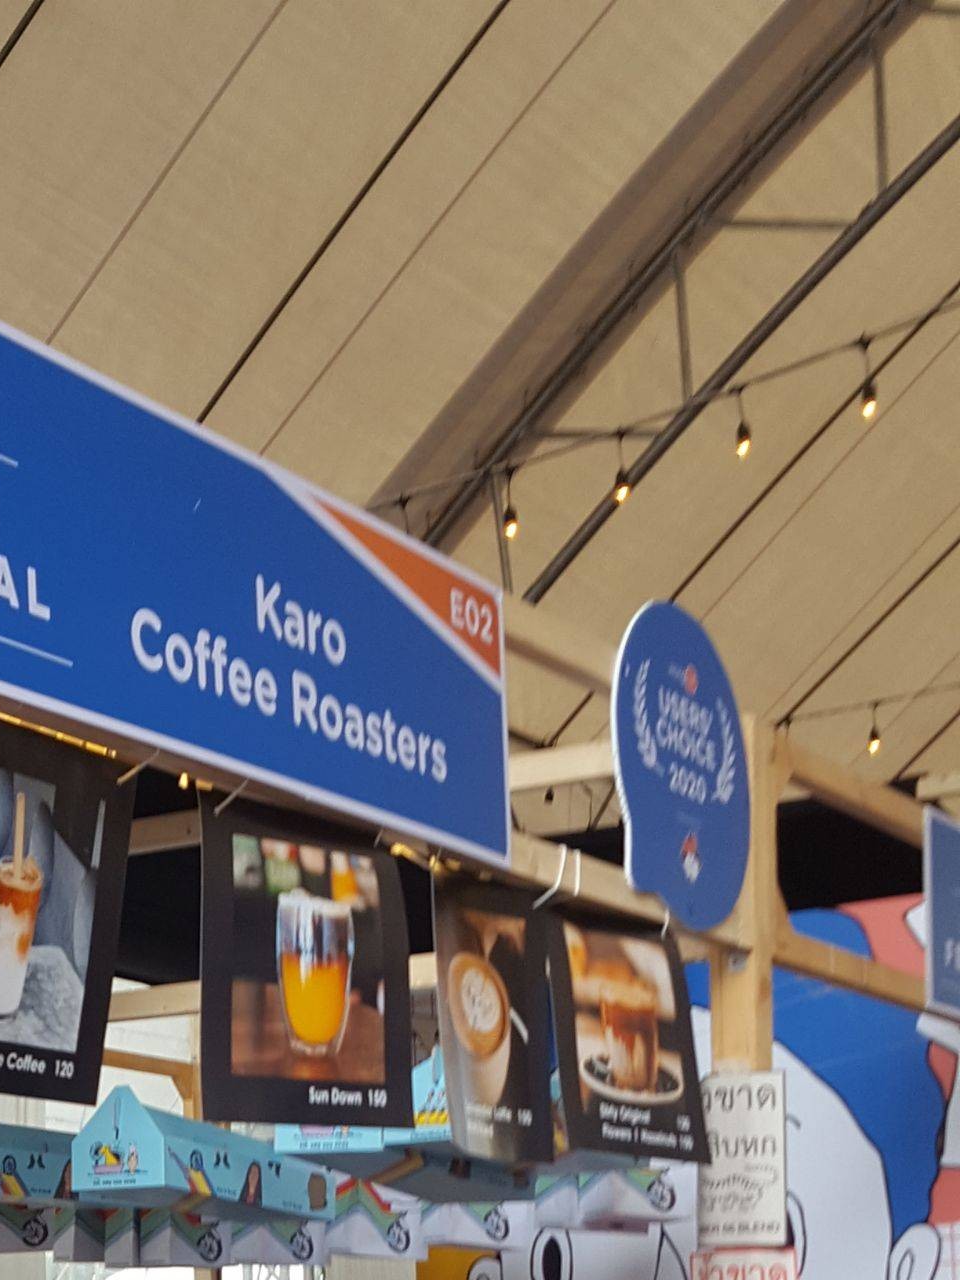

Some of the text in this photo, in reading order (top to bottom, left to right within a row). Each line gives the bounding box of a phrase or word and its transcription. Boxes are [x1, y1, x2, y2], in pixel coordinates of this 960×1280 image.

[255, 573, 347, 665] Karo
[449, 587, 493, 645] E02
[131, 607, 448, 783] Coffee Roasters
[669, 761, 707, 806] 2020
[6, 1051, 47, 1075] Coffee
[54, 1059, 75, 1079] 120
[308, 1085, 330, 1105] Sun
[331, 1086, 363, 1107] Down
